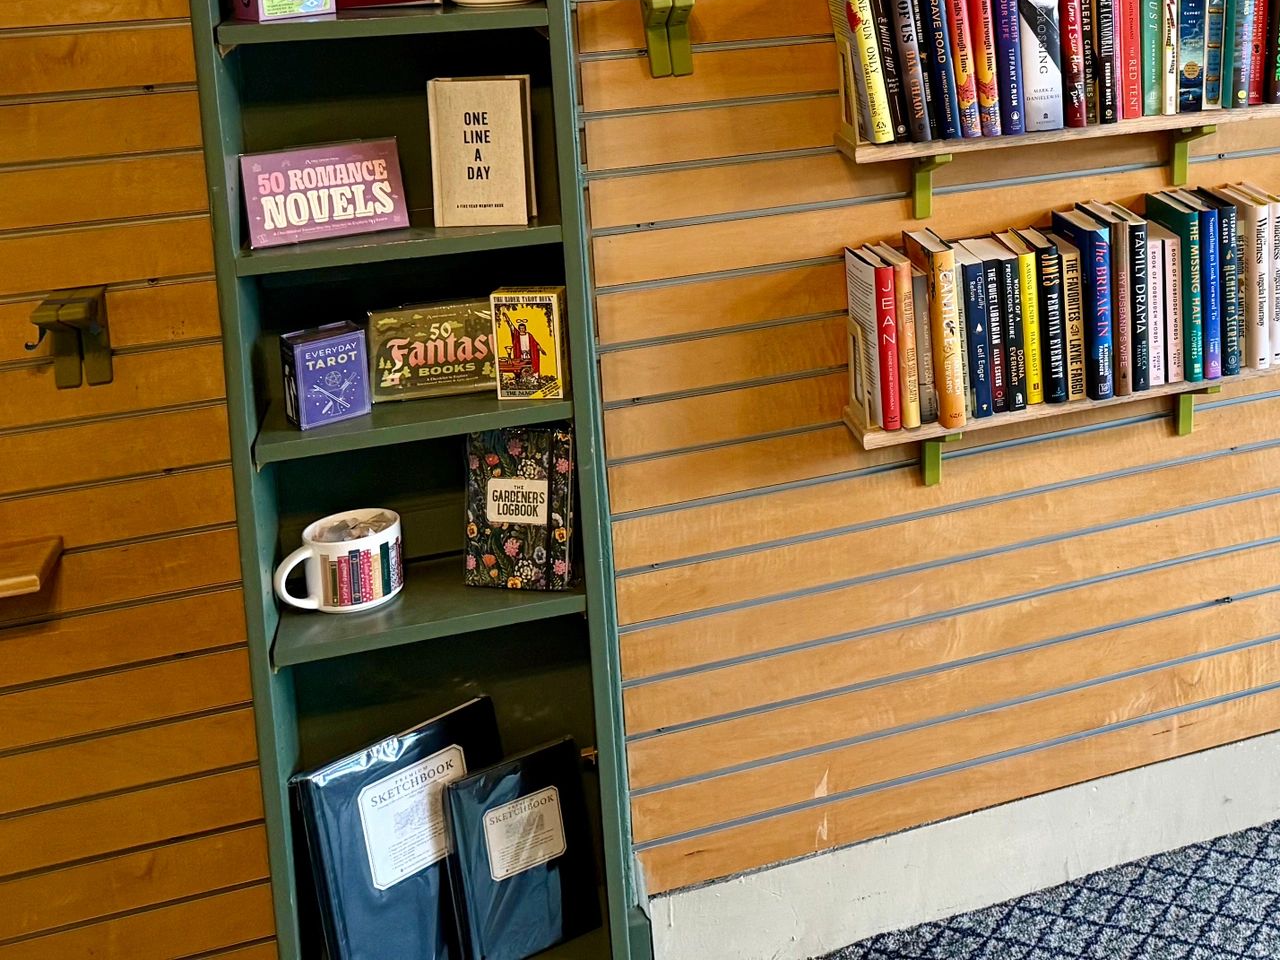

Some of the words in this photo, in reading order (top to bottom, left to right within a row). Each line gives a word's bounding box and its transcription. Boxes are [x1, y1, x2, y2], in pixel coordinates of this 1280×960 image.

[934, 32, 946, 63] ROAD
[1036, 6, 1048, 75] CROSSING
[1084, 40, 1092, 65] CARYS
[1129, 59, 1137, 80] RED
[1130, 85, 1138, 111] TENT
[464, 112, 488, 126] ONE
[464, 130, 491, 144] LINE
[475, 148, 482, 161] A
[258, 172, 285, 194] 50
[288, 159, 388, 190] ROMANCE
[468, 166, 490, 180] DAY
[261, 181, 394, 230] NOVELS
[1189, 220, 1199, 240] THE
[1066, 258, 1079, 274] THE
[1135, 231, 1145, 278] FAMILY
[1041, 254, 1060, 287] JAMES
[1190, 245, 1200, 293] MISSING
[881, 280, 896, 345] JEAN
[1067, 277, 1080, 322] FAVORITES
[1136, 284, 1146, 334] DRAMA
[1192, 298, 1201, 325] HALF
[430, 323, 451, 339] 50
[989, 306, 1000, 344] LIBRARIAN
[305, 341, 357, 360] EVERYDAY
[306, 351, 357, 371] TAROT
[1070, 339, 1082, 365] LAYNE
[419, 362, 476, 376] BOOKS
[1071, 368, 1083, 395] FARGO
[498, 503, 538, 517] LOGBOOK
[371, 759, 454, 807] SKETCHBOOK
[489, 794, 554, 825] SKETCHBOOK
